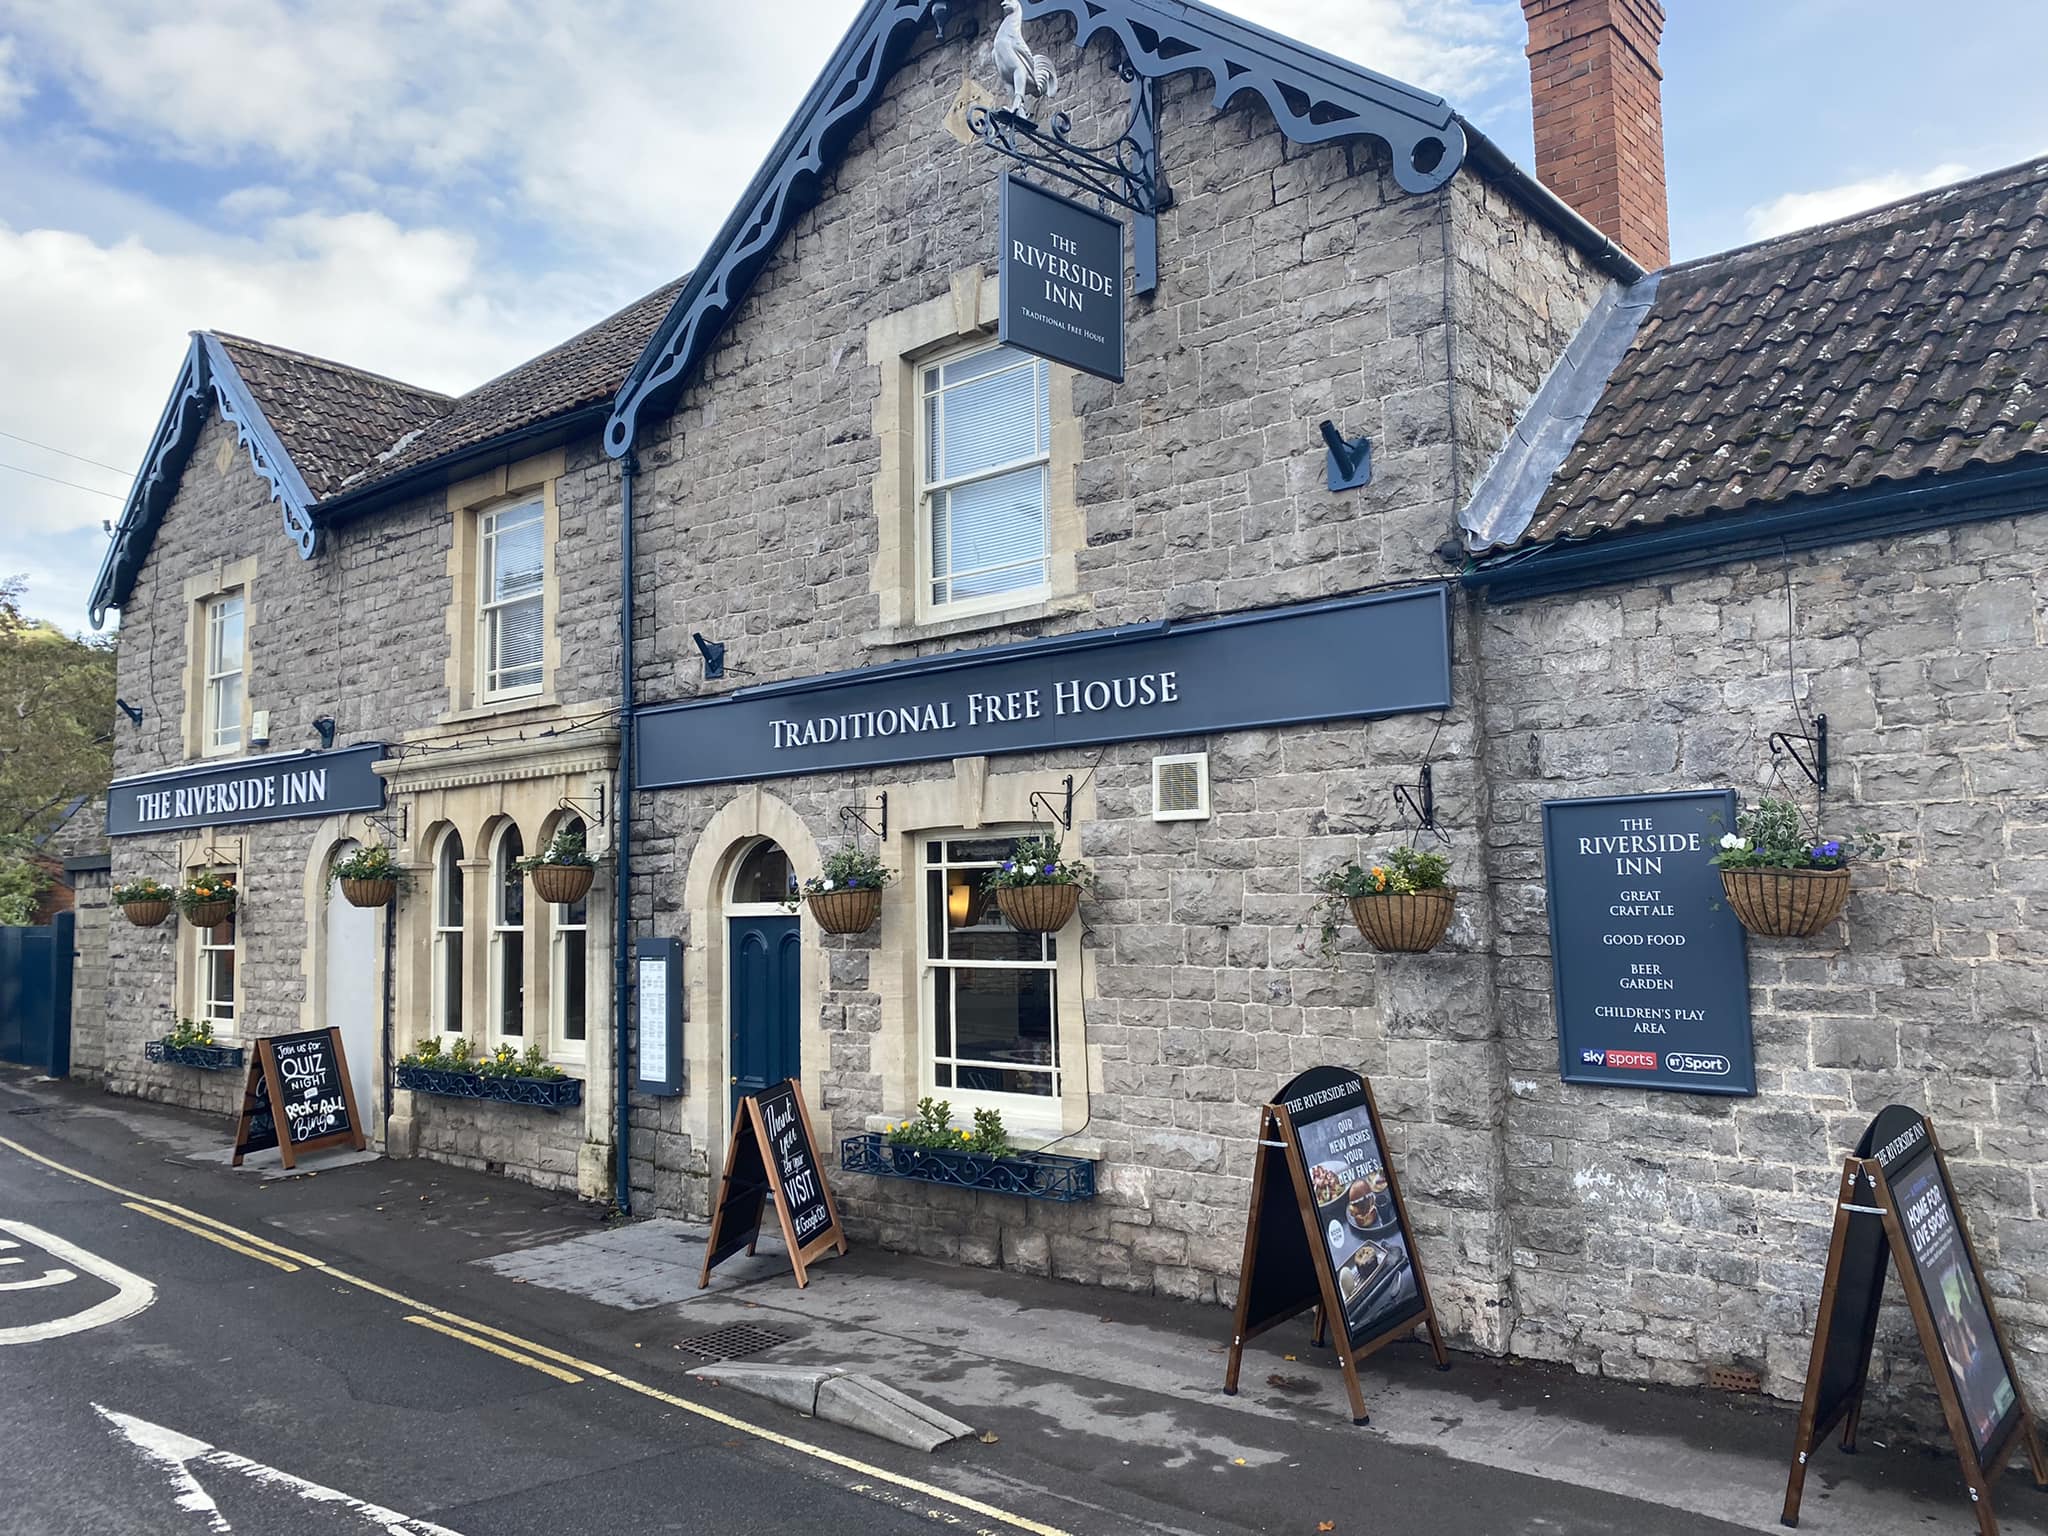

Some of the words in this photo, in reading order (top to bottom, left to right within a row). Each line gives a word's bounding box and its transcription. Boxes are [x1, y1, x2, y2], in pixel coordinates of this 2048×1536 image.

[1050, 232, 1077, 256] THE
[1013, 240, 1112, 297] RIVERSIDE
[1045, 280, 1082, 312] INN
[1021, 306, 1065, 330] TRADITIONAL
[1067, 323, 1082, 336] FREE
[1084, 329, 1105, 344] HOUSE
[769, 701, 956, 749] TRADITIONAL
[968, 689, 1040, 726] FREE
[1054, 671, 1179, 716] HOUSE
[136, 791, 171, 822] THE
[174, 776, 275, 818] RIVERSIDE
[281, 768, 328, 806] INN
[1620, 818, 1653, 831] THE
[1578, 833, 1701, 855] RIVERSIDE
[1616, 857, 1663, 875] INN
[1620, 890, 1661, 901] GREAT
[1609, 905, 1650, 916] CRAFT
[1652, 905, 1675, 916] ALE
[1603, 934, 1644, 945] GOOD
[1647, 934, 1686, 946] FOOD
[1631, 963, 1662, 975] BEER
[1619, 978, 1674, 990] GARDEN
[1594, 1006, 1671, 1020] CHILDREN'S
[1675, 1009, 1705, 1021] PLAY
[1633, 1022, 1667, 1034] AREA
[277, 1044, 295, 1060] Join
[296, 1043, 306, 1053] us
[307, 1042, 320, 1054] for
[1583, 1050, 1605, 1065] sky
[1608, 1054, 1654, 1066] sports
[281, 1053, 327, 1083] QUIZ
[1669, 1058, 1681, 1067] BT
[1685, 1057, 1723, 1070] Sport
[291, 1071, 326, 1090] NIGHT
[1285, 1097, 1304, 1115] THE
[1303, 1083, 1347, 1109] RIVERSIDE
[1345, 1079, 1361, 1095] INN
[285, 1100, 313, 1120] ROCK
[319, 1096, 345, 1115] ROLL
[293, 1114, 335, 1141] Bingo
[763, 1096, 796, 1142] Thank
[1337, 1118, 1354, 1134] OUR
[1328, 1135, 1347, 1154] NEW
[1886, 1130, 1916, 1162] RIVERSIDE
[1912, 1121, 1926, 1142] INN
[1343, 1148, 1364, 1165] YOUR
[1355, 1157, 1379, 1178] FAVE'S
[784, 1168, 815, 1209] VISIT
[1906, 1195, 1930, 1229] HOME
[1926, 1184, 1943, 1211] FOR
[799, 1209, 819, 1233] Google
[1912, 1221, 1931, 1252] LIVE
[1927, 1203, 1950, 1239] SPORT
